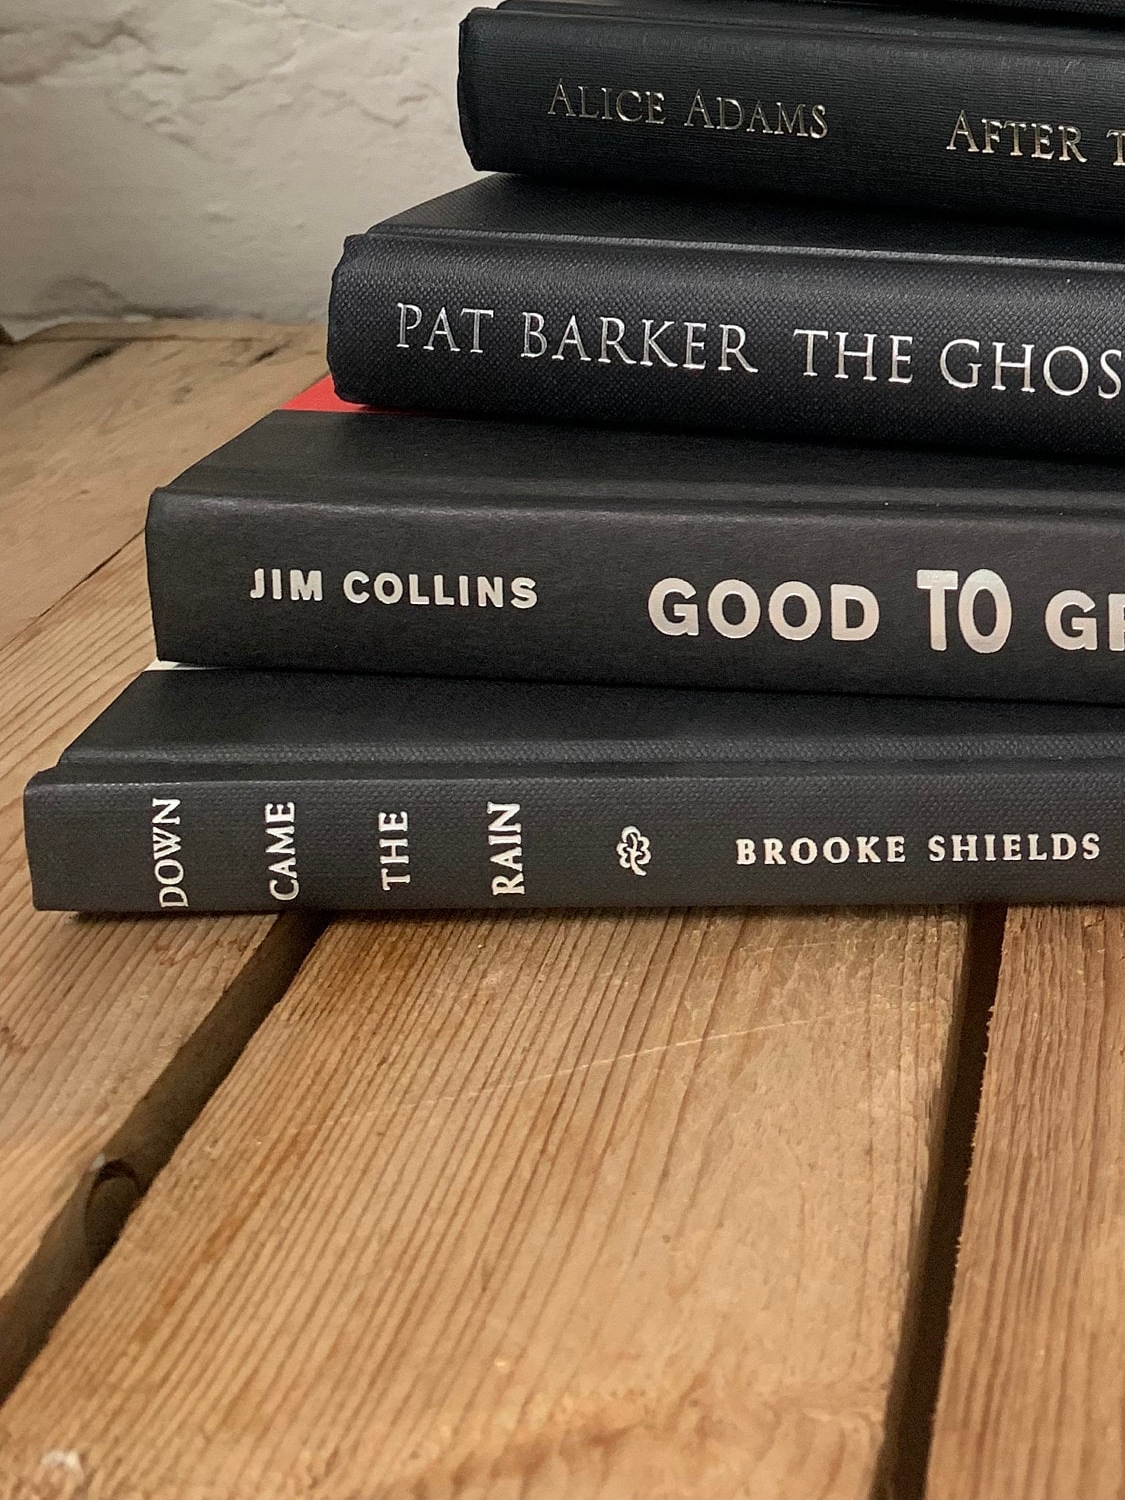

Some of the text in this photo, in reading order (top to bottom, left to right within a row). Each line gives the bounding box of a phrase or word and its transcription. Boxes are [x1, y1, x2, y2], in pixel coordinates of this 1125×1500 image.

[547, 78, 828, 139] ALICE ADAMS
[946, 109, 1087, 163] AFTER
[396, 302, 758, 373] PAT BARKER
[794, 329, 914, 383] THE
[250, 568, 538, 609] JIM COLLINS
[648, 577, 880, 641] GOOD
[916, 568, 1013, 654] TO
[152, 797, 189, 908] DOWN
[265, 801, 300, 901] CAME
[378, 810, 411, 891] THE
[487, 801, 525, 897] RAIN
[736, 833, 1101, 865] BROOKE SHIELDS
